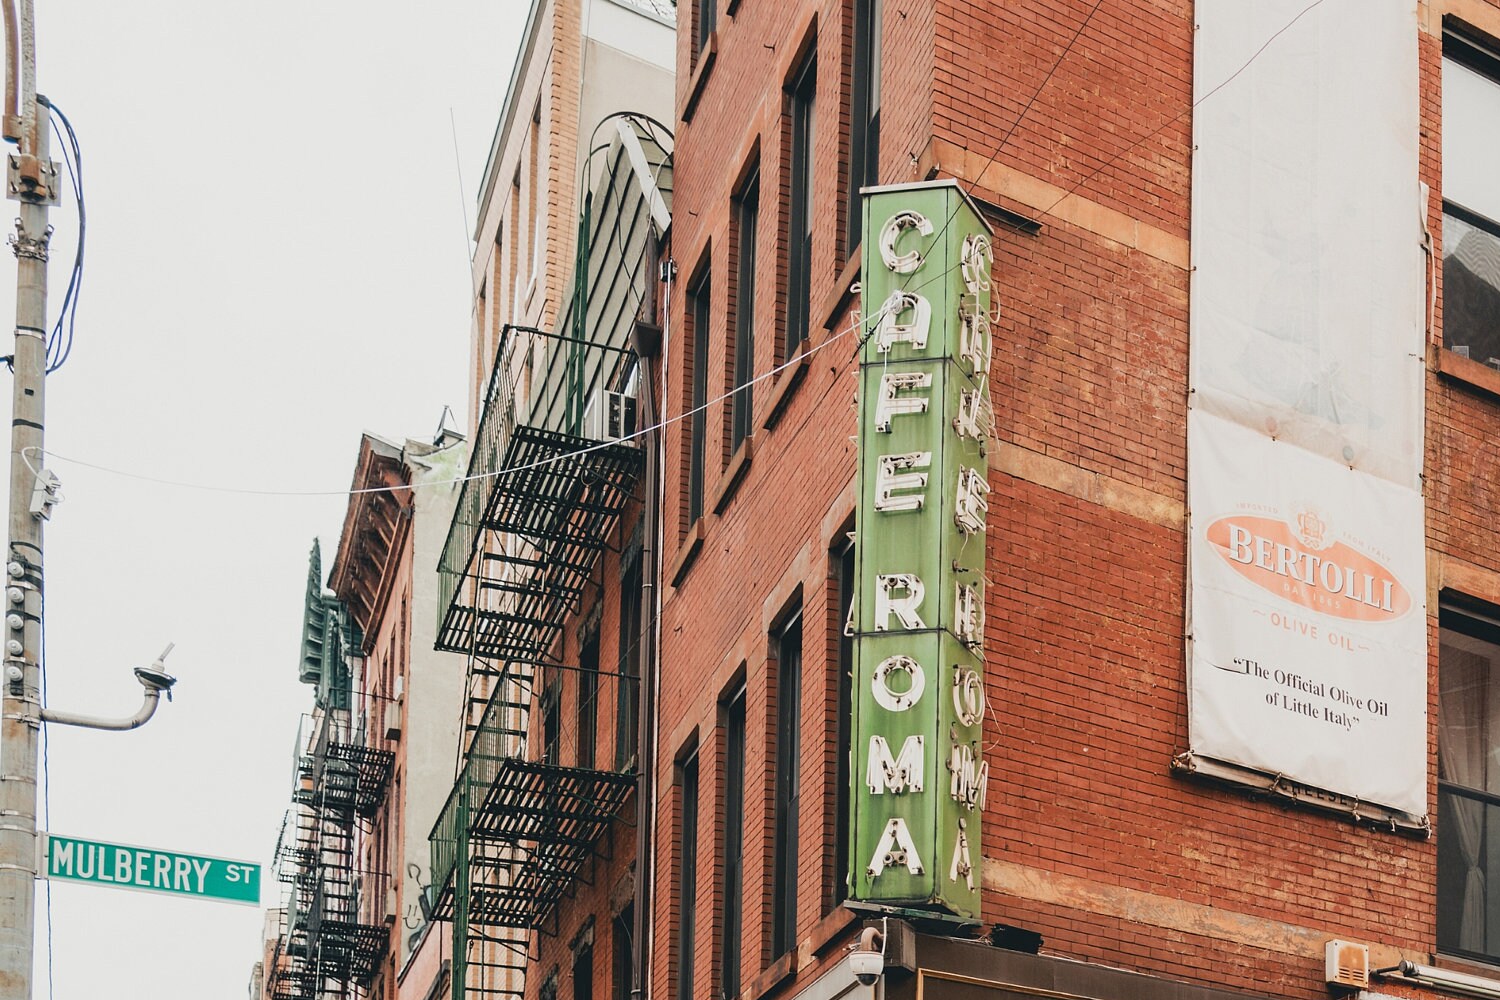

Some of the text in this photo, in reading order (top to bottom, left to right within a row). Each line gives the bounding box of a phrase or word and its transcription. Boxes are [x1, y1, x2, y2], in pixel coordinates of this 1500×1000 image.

[1228, 523, 1394, 613] BERTOLLI
[1270, 612, 1354, 652] OLIVE OIL
[1265, 692, 1279, 706] of
[1283, 696, 1319, 718] Little
[1274, 669, 1325, 697] Official
[1330, 687, 1363, 709] Olive
[1367, 699, 1388, 716] Oil
[866, 573, 927, 877] ROMA
[52, 837, 255, 894] MULBERRY ST
